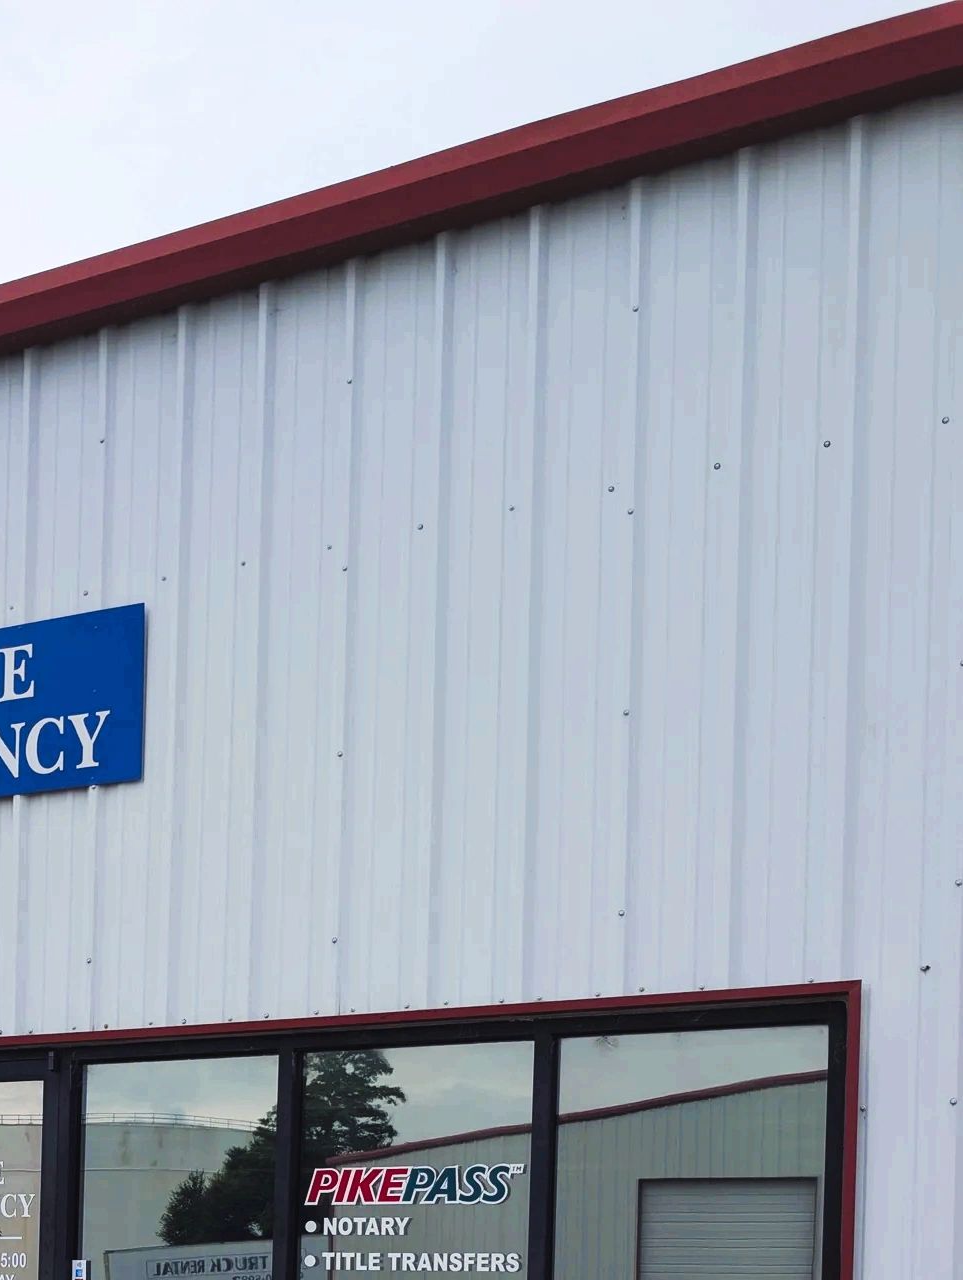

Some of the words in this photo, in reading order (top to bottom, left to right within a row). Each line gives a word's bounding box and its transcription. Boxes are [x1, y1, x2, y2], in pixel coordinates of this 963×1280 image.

[304, 1163, 512, 1206] PIKEPASS
[323, 1217, 411, 1236] NOTARY
[0, 1252, 27, 1268] 5:00
[321, 1252, 381, 1271] TITLE
[387, 1252, 521, 1273] TRANSFERS
